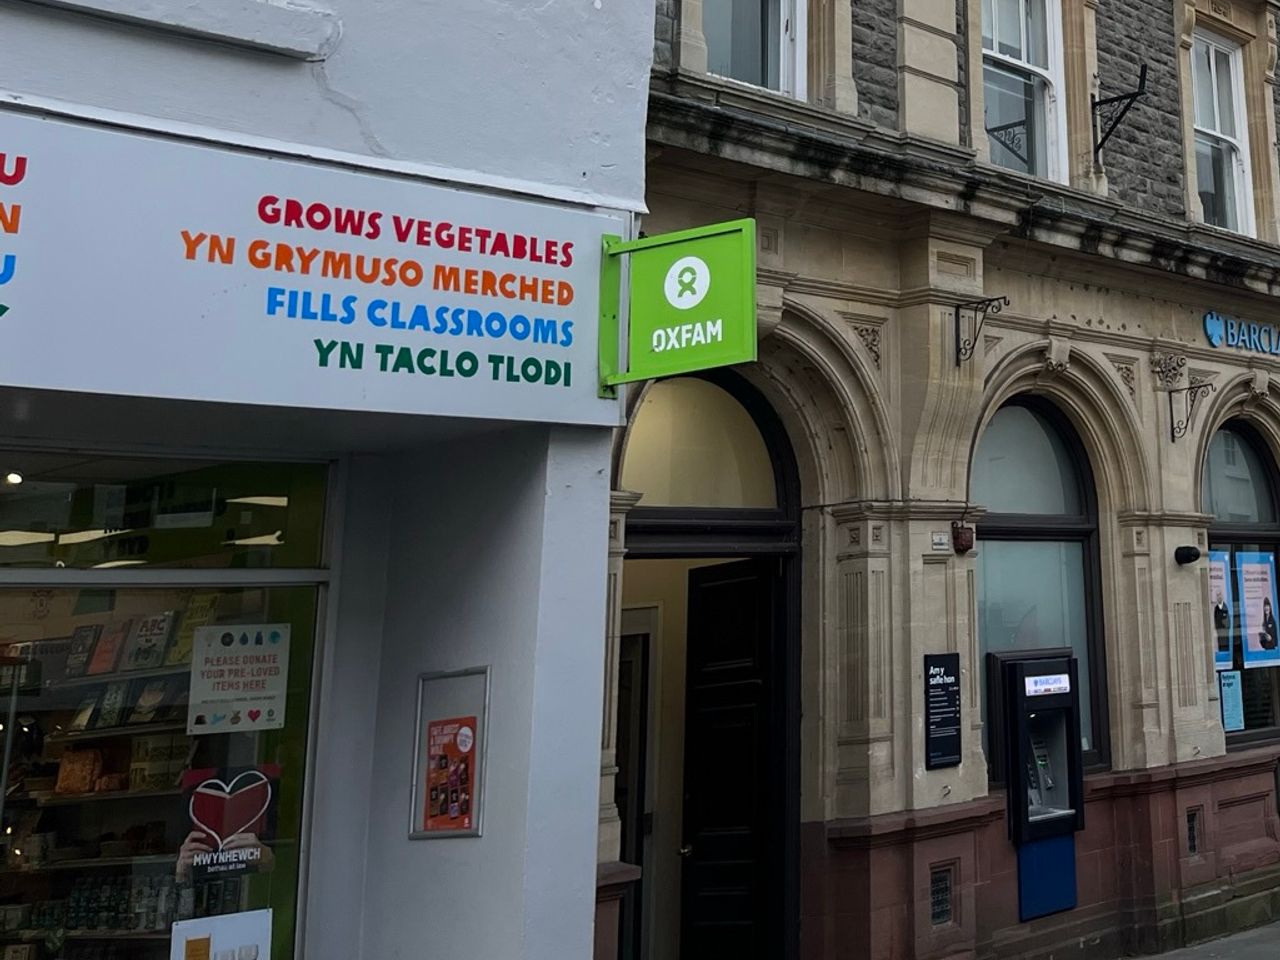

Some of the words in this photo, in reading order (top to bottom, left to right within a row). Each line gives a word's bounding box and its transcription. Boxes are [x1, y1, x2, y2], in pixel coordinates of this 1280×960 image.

[257, 195, 382, 240] GROWS
[392, 215, 574, 268] VEGETABLES
[180, 230, 236, 265] YN
[248, 239, 423, 287] GRYMUSO
[433, 264, 574, 307] MERCHED
[266, 286, 358, 325] FILLS
[366, 298, 574, 348] CLASSROOMS
[652, 318, 723, 352] OXFAM
[313, 338, 364, 370] YN
[375, 343, 479, 378] TACLO
[487, 353, 572, 387] TLODI
[200, 668, 225, 680] YOUR
[227, 666, 280, 679] PRE-LOVED
[204, 655, 240, 667] PLEASE
[243, 653, 278, 665] DONATE
[212, 681, 240, 691] ITEMS
[242, 679, 267, 690] HERE
[193, 847, 261, 866] MWYNHEWCH
